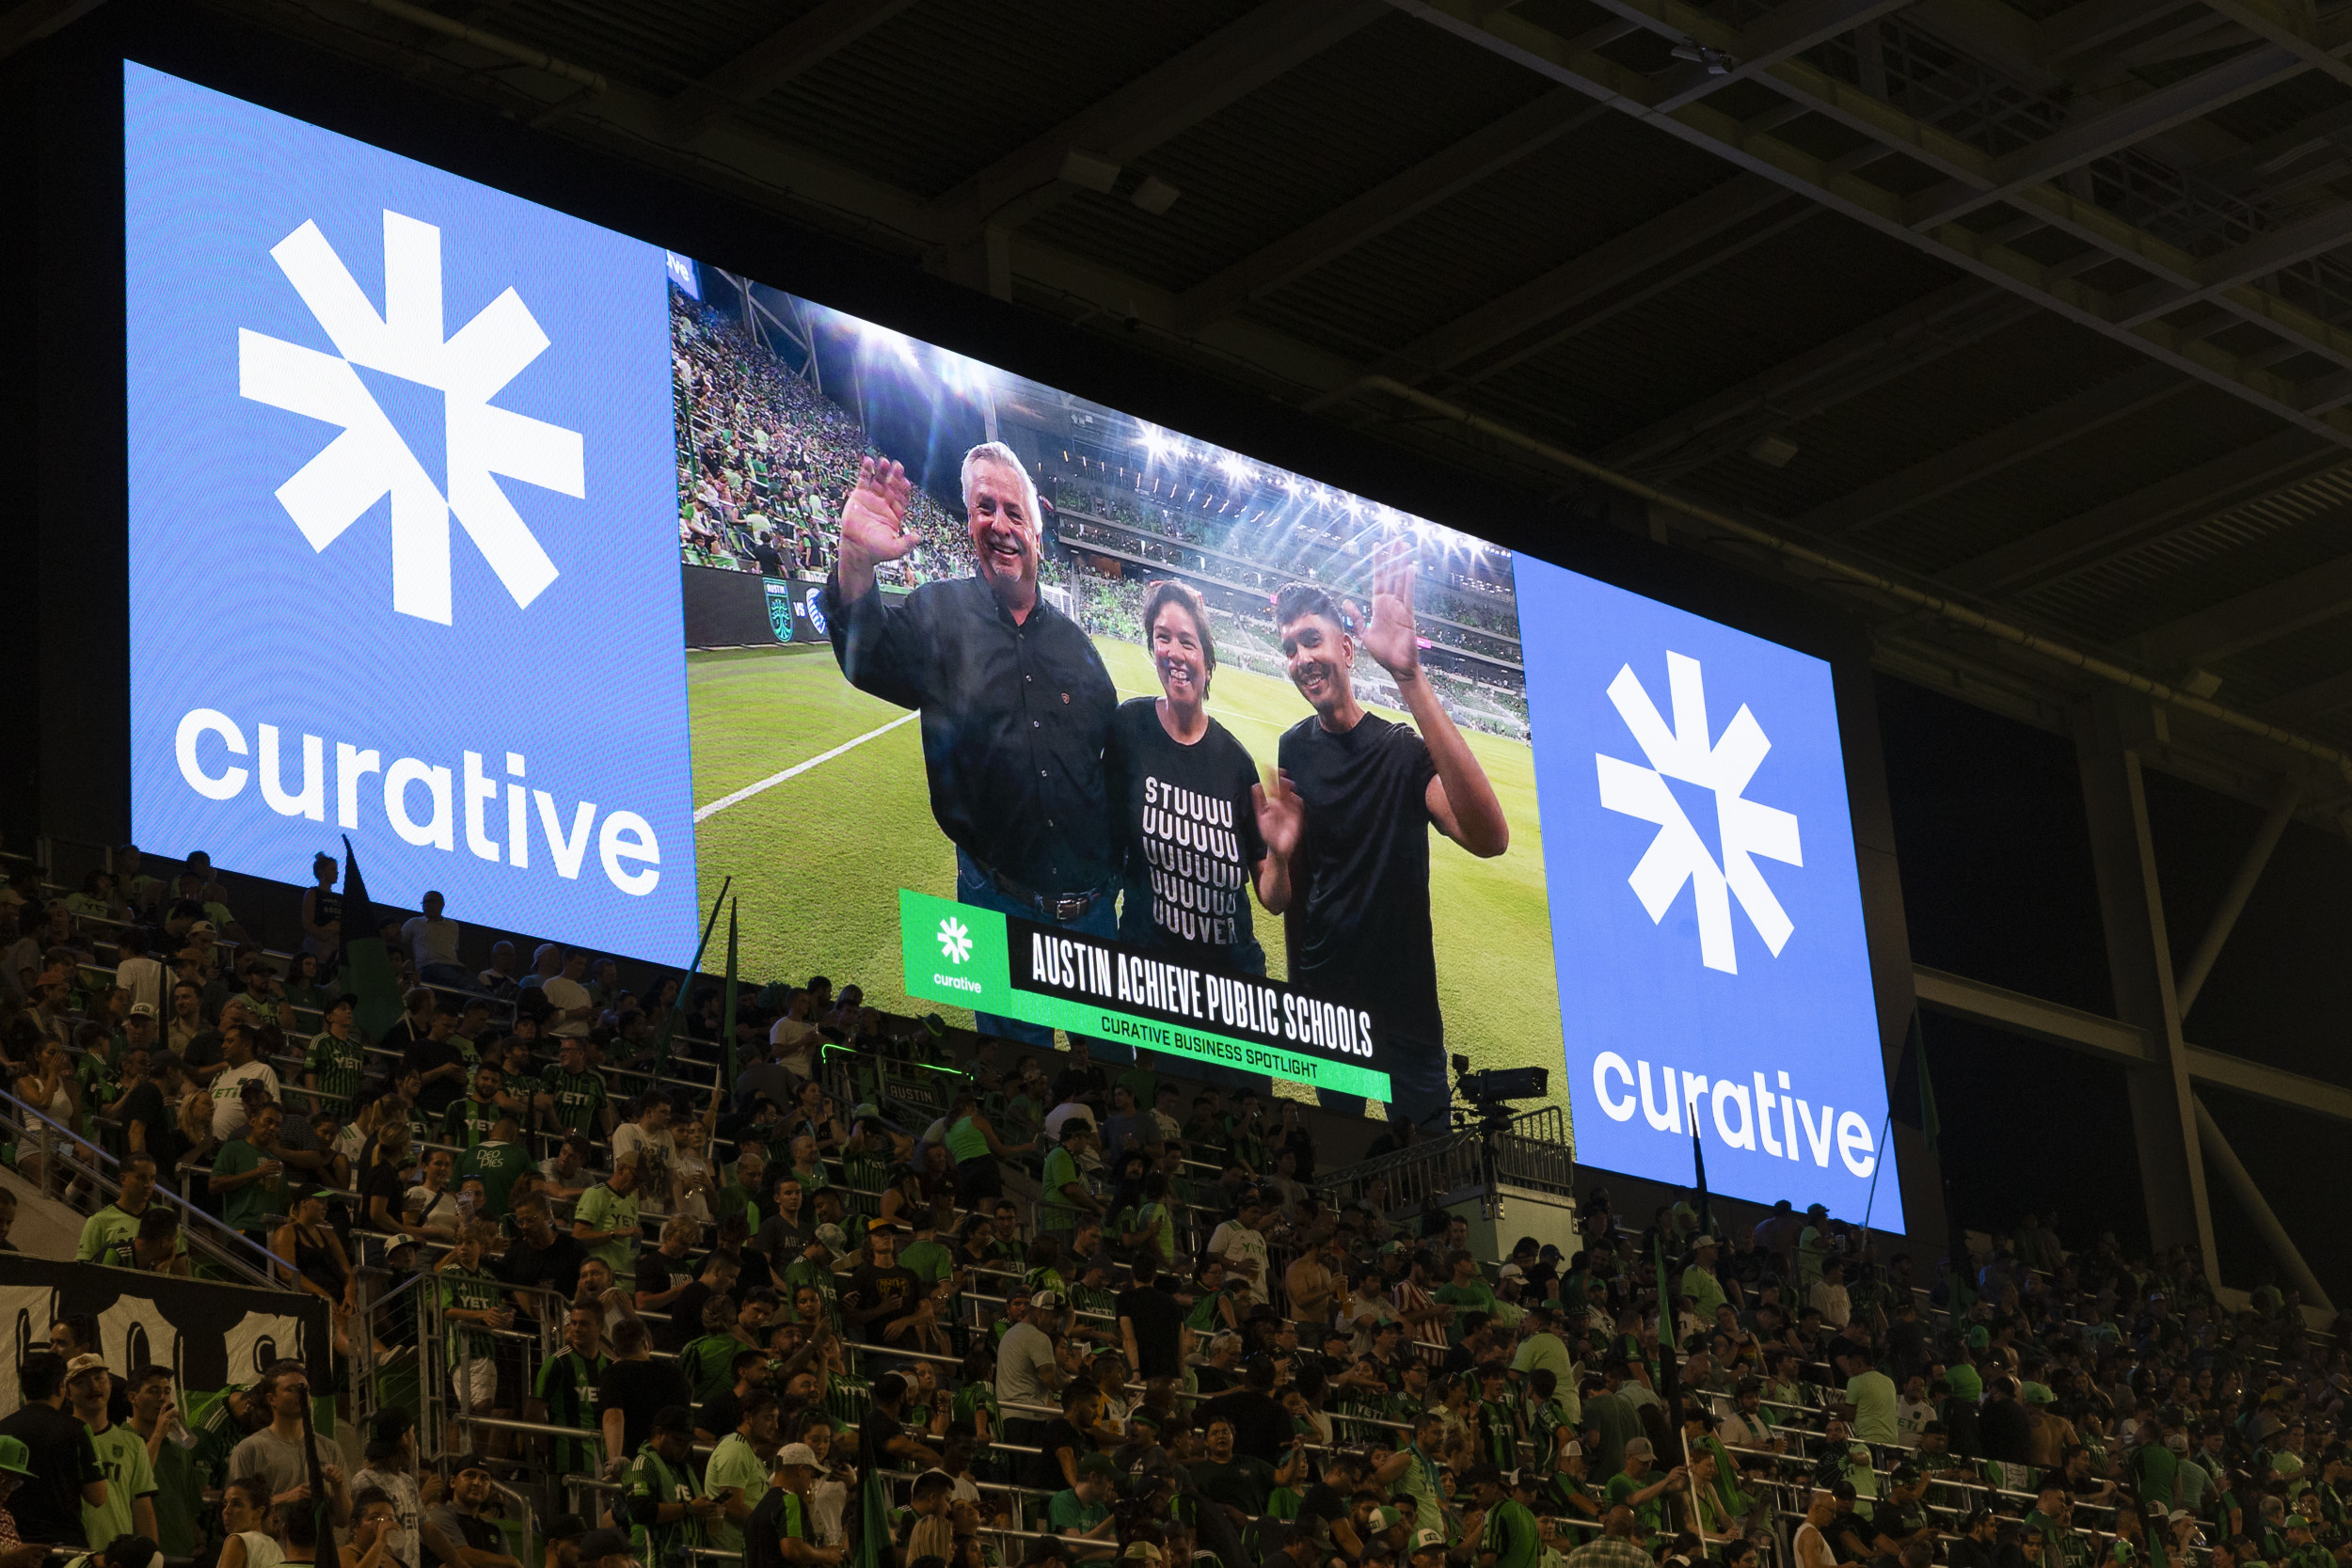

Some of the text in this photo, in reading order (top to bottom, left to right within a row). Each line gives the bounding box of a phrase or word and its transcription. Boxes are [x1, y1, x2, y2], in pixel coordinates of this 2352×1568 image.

[793, 601, 806, 617] VS
[175, 707, 660, 896] curative
[1145, 775, 1233, 829] STUUUU
[1142, 805, 1239, 863] UUUUUU
[1142, 836, 1242, 891] UUUUUU
[1149, 865, 1236, 916] UUUUUU
[1152, 895, 1239, 945] UUUVER
[933, 973, 982, 994] curative
[1032, 931, 1374, 1058] AUSTIN ACHIEVE PUBLIC SCHOOLS
[1101, 1015, 1318, 1080] CURATIVE BUSINESS SPOTLIGHT
[333, 1056, 363, 1070] YETI
[890, 1085, 933, 1104] AUSTIN
[1593, 1051, 1876, 1179] curative
[464, 1118, 496, 1132] YET
[476, 1149, 501, 1161] DEO
[482, 1157, 505, 1170] PIES
[864, 1158, 886, 1171] YETI
[670, 1273, 693, 1290] AUST
[818, 1284, 838, 1301] YET
[574, 1386, 600, 1402] YE
[1357, 1403, 1384, 1420] YETI
[1897, 1418, 1918, 1433] ETI
[675, 1483, 692, 1501] YE
